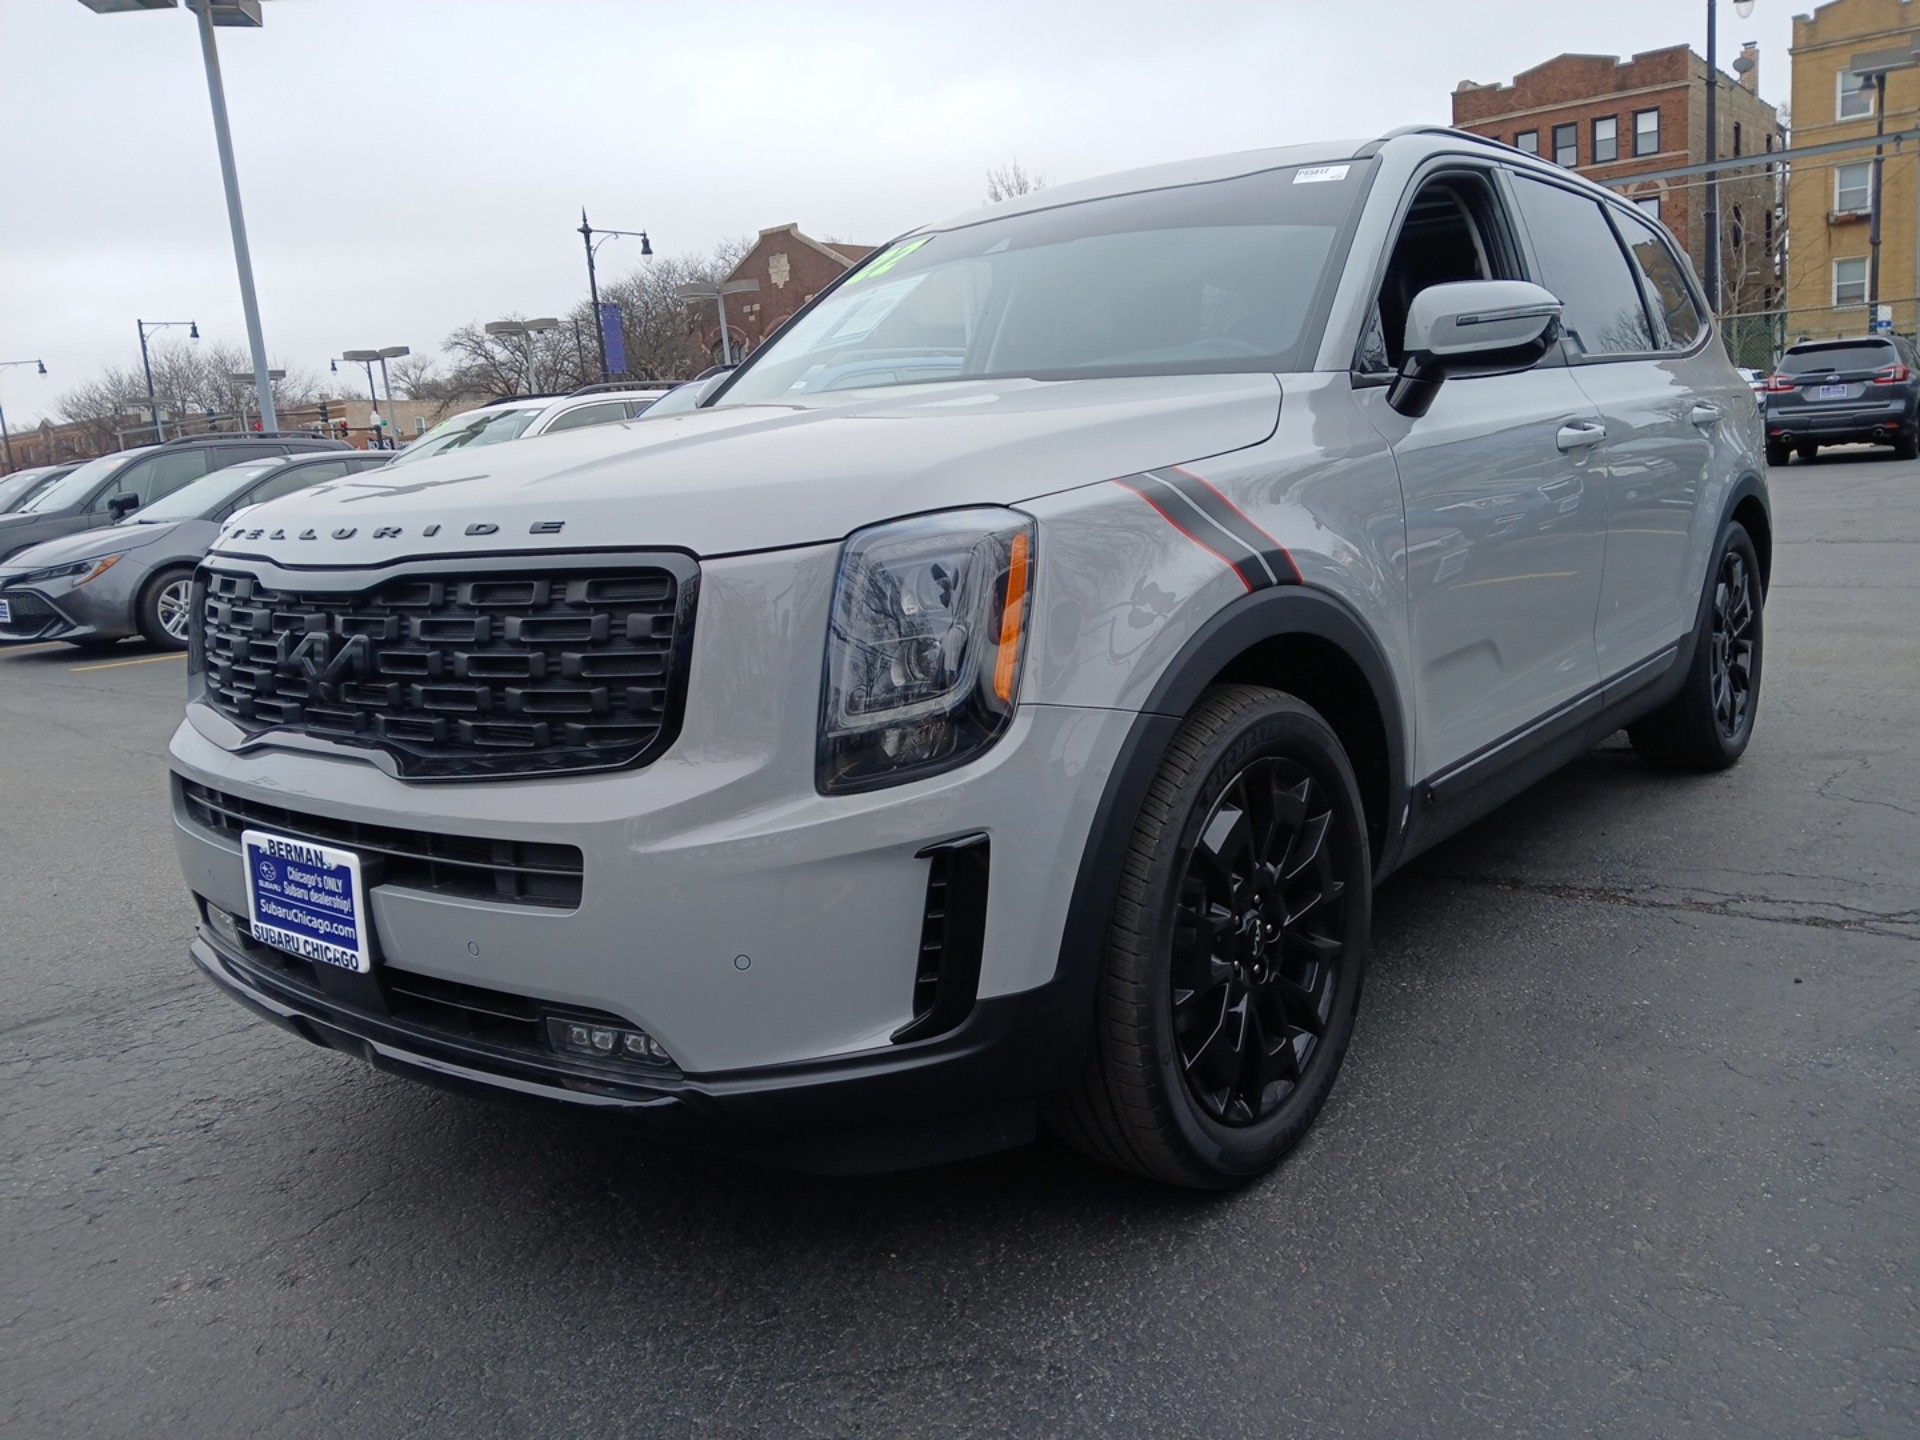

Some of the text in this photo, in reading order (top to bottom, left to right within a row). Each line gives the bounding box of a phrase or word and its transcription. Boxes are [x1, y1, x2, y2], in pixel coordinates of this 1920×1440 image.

[230, 520, 566, 541] TELLURIDE
[268, 839, 323, 867] BERMAN
[287, 866, 343, 893] Chicago's ONLY
[283, 881, 352, 914] Subaru dealership!
[260, 899, 356, 939] SubaruChicago.com
[254, 924, 360, 971] SUBARU CHICAGO
